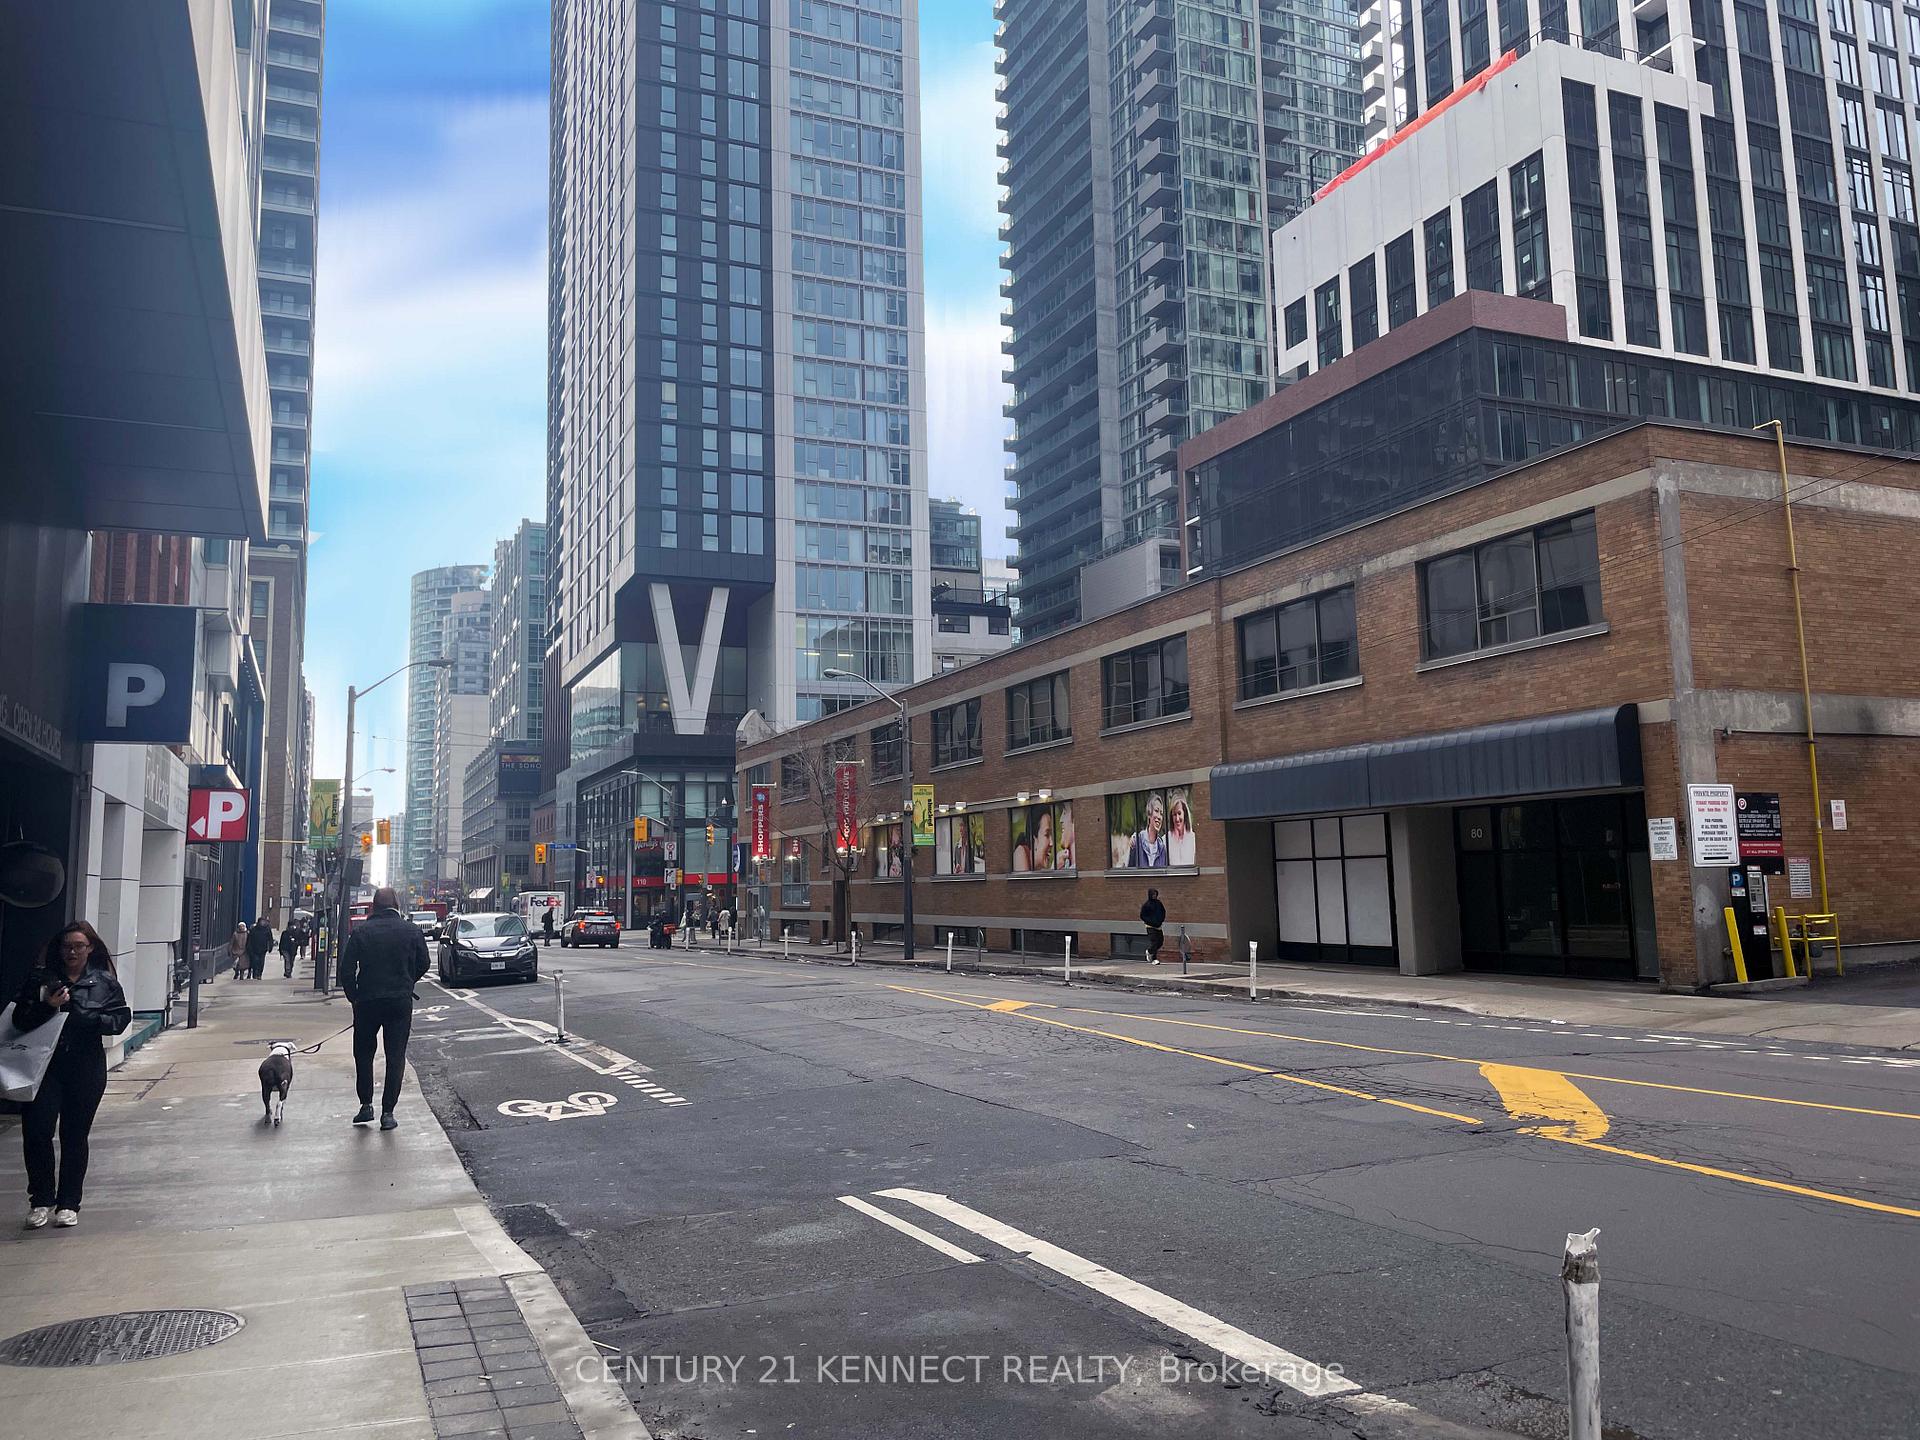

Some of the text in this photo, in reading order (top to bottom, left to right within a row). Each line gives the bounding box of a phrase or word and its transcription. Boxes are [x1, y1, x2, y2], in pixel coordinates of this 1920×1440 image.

[106, 662, 166, 727] P
[207, 791, 246, 839] P
[1471, 829, 1482, 838] 80
[1732, 874, 1740, 885] P
[531, 896, 561, 906] FedEx
